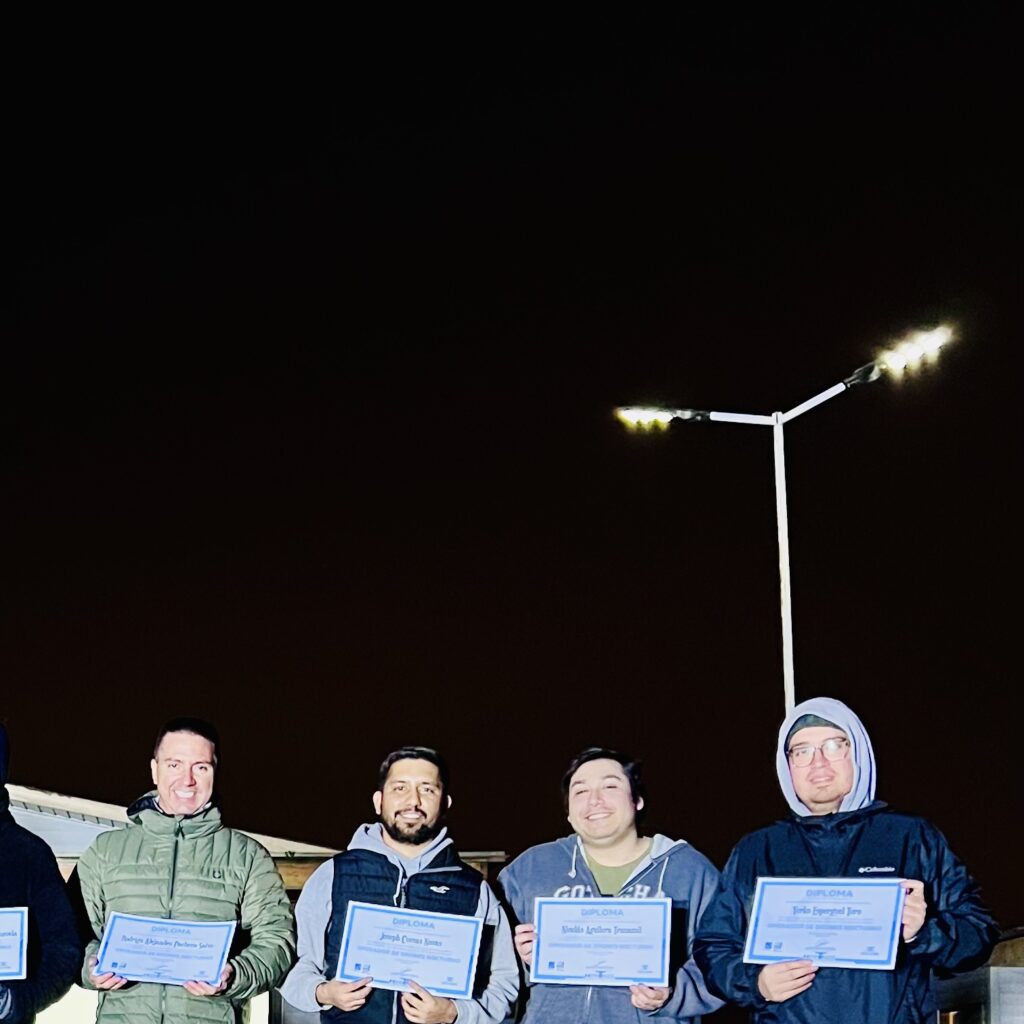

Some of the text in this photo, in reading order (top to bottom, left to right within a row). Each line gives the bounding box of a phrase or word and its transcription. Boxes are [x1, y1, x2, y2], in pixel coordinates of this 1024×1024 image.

[805, 889, 853, 897] DIPLOMA
[392, 918, 435, 929] DIPLOMA
[150, 926, 191, 934] DIPLOMA
